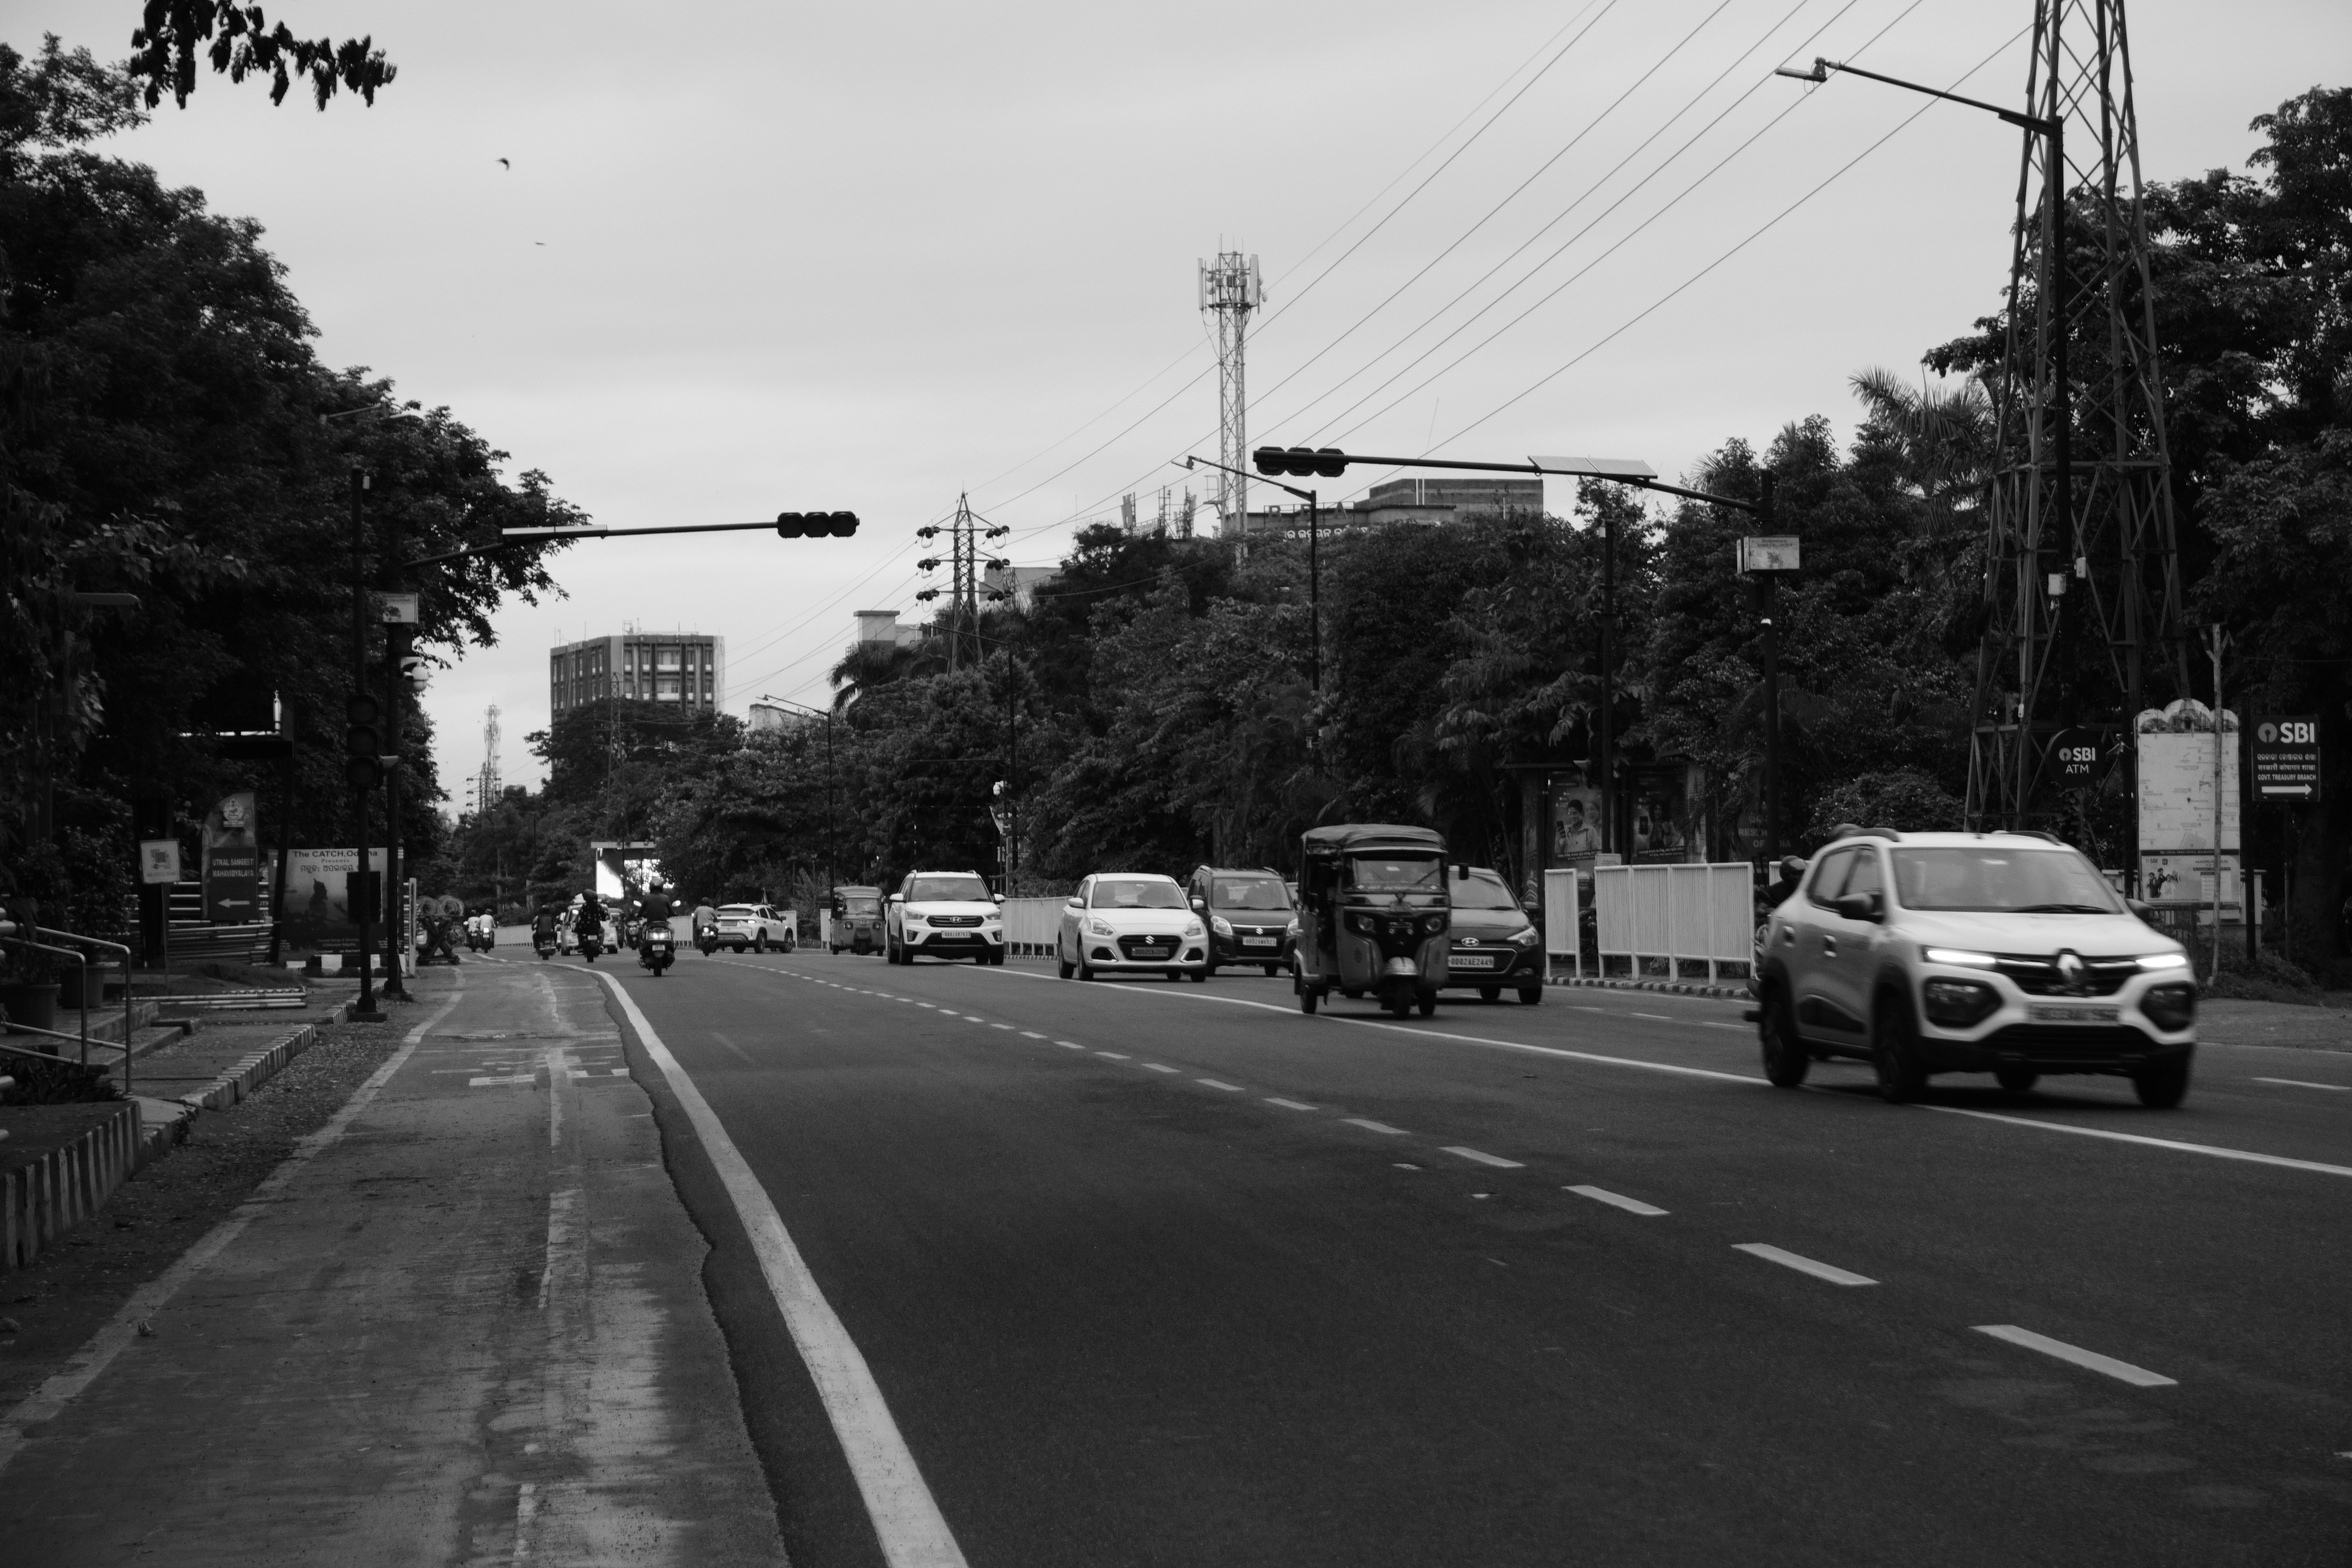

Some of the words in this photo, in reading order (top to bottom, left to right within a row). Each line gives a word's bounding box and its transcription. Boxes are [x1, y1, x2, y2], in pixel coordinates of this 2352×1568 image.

[2280, 722, 2315, 743] SBI
[2073, 747, 2095, 762] SBI
[2065, 764, 2089, 773] ATM
